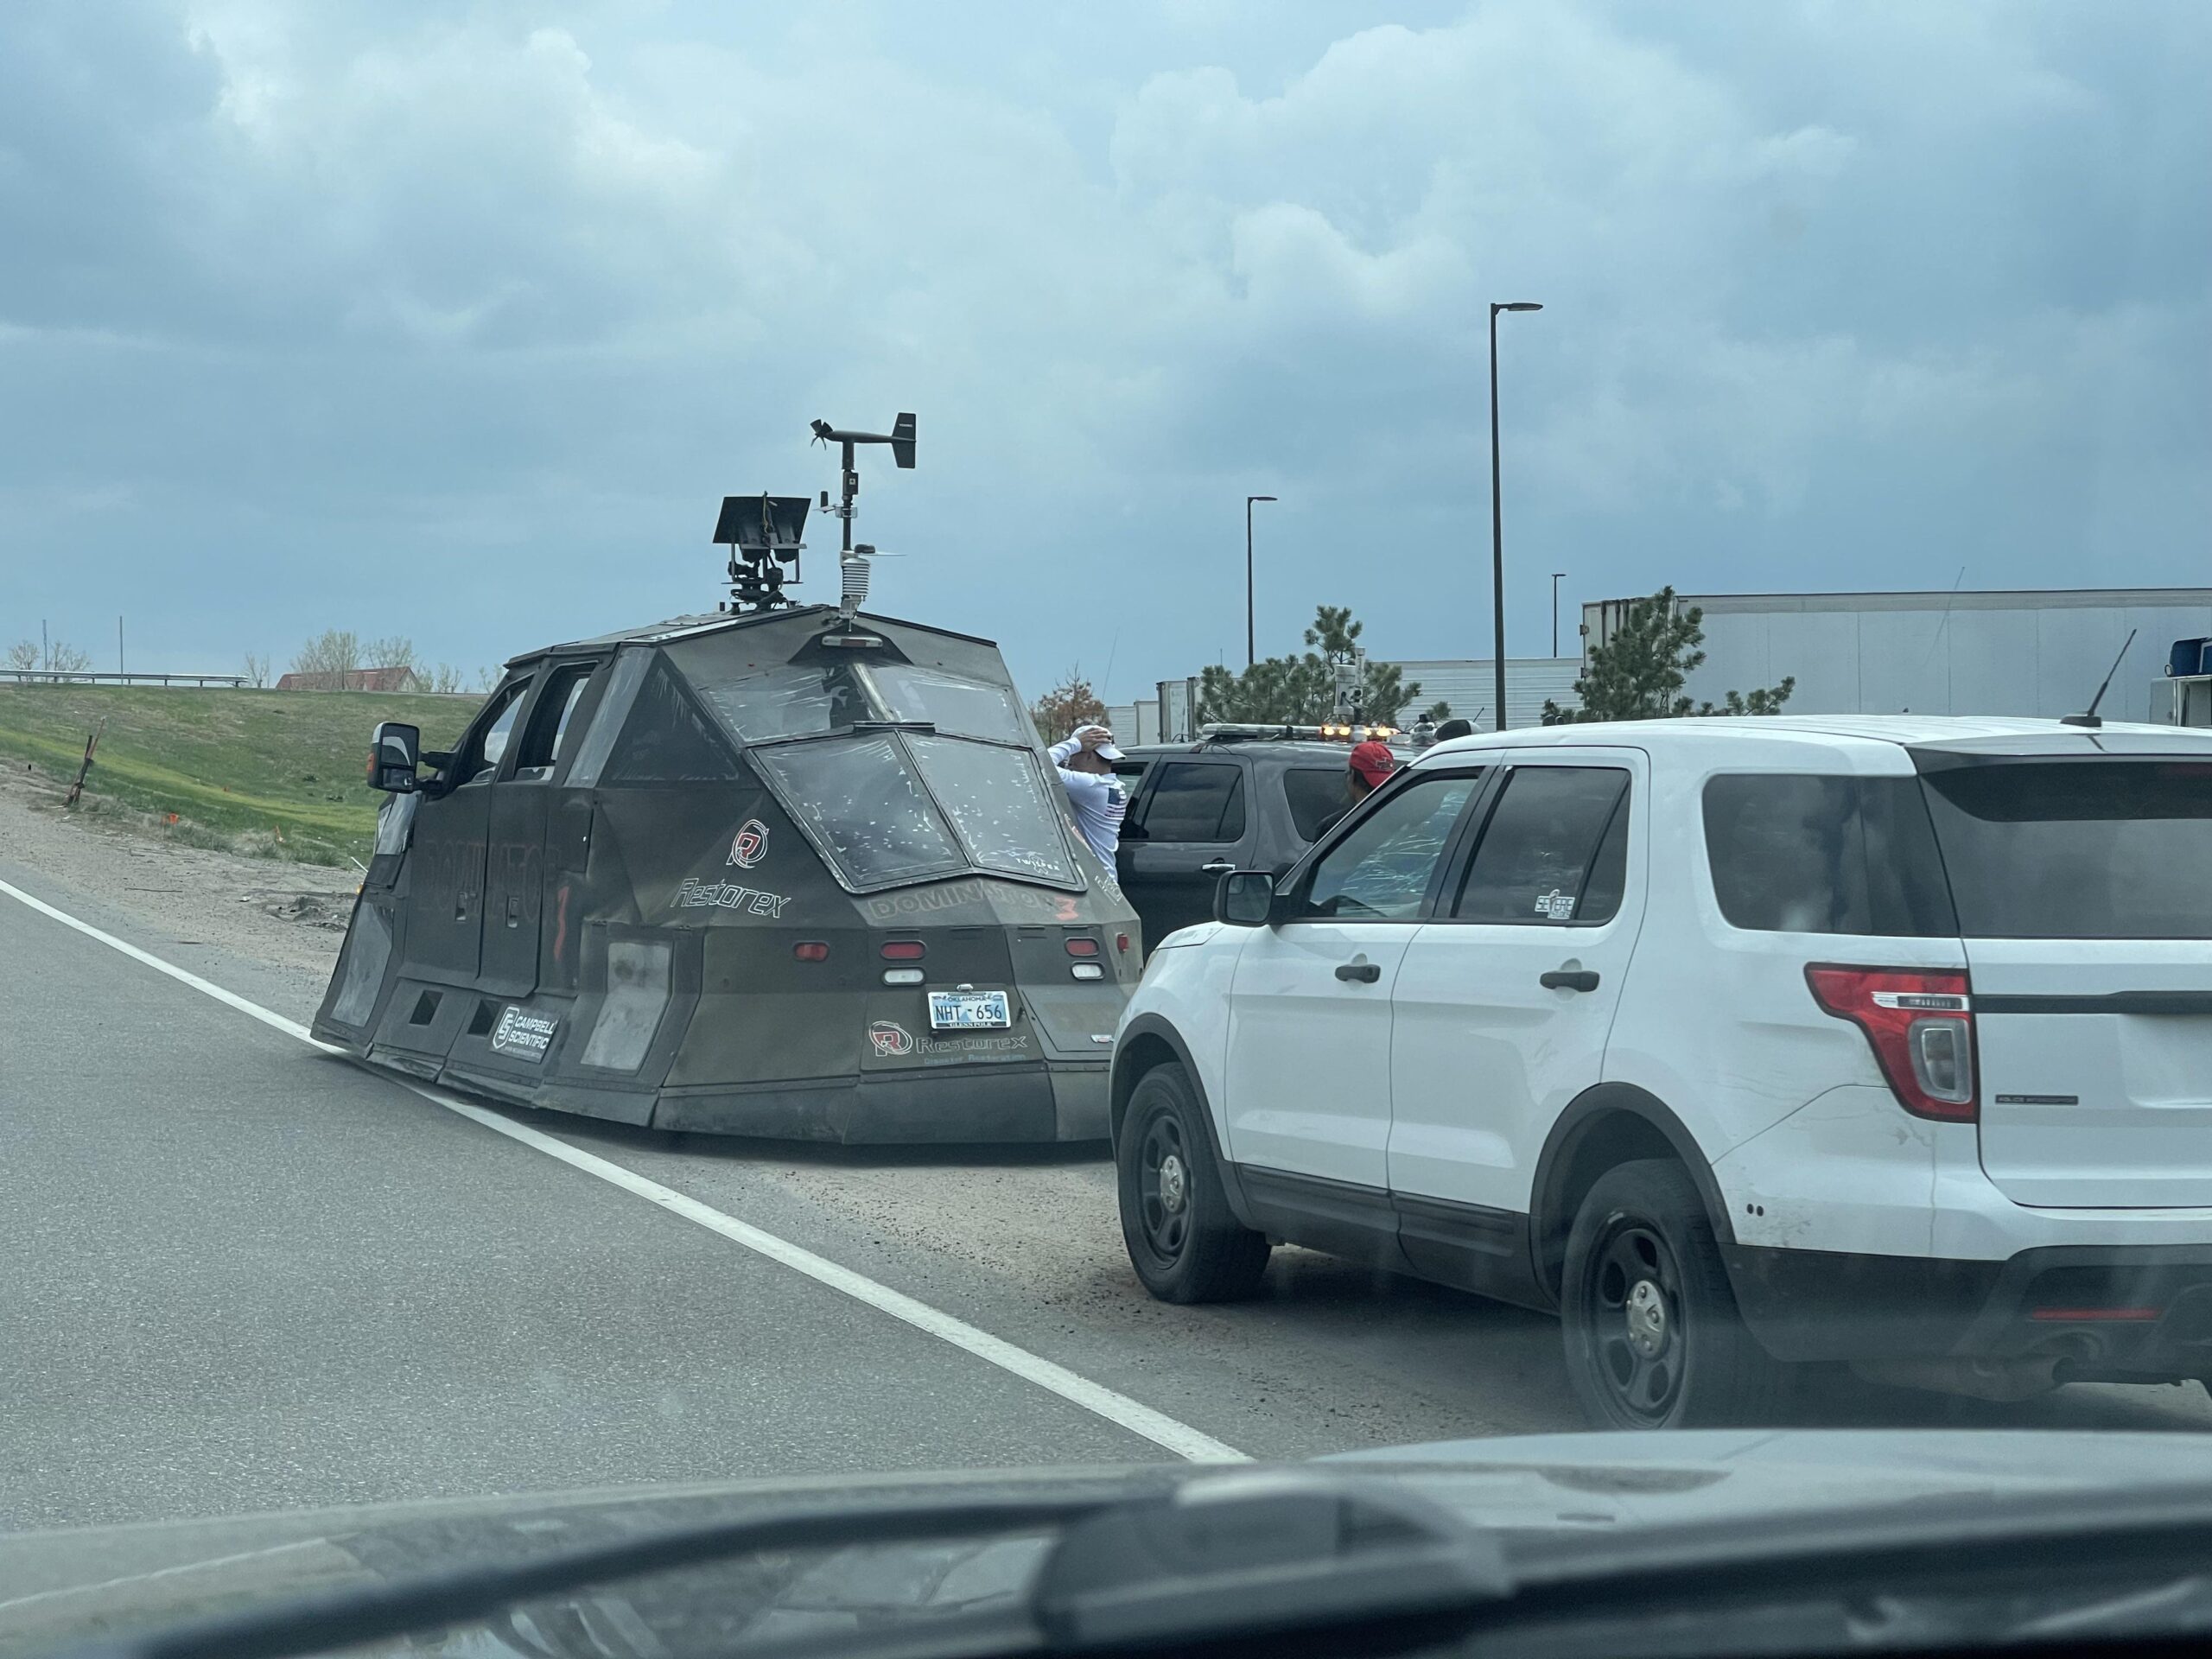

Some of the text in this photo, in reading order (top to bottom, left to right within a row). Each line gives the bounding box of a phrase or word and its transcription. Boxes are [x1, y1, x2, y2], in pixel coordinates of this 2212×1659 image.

[670, 877, 791, 918] Restorex
[514, 1015, 556, 1035] CAMPBELL
[507, 1030, 550, 1050] SCIENTIFIC
